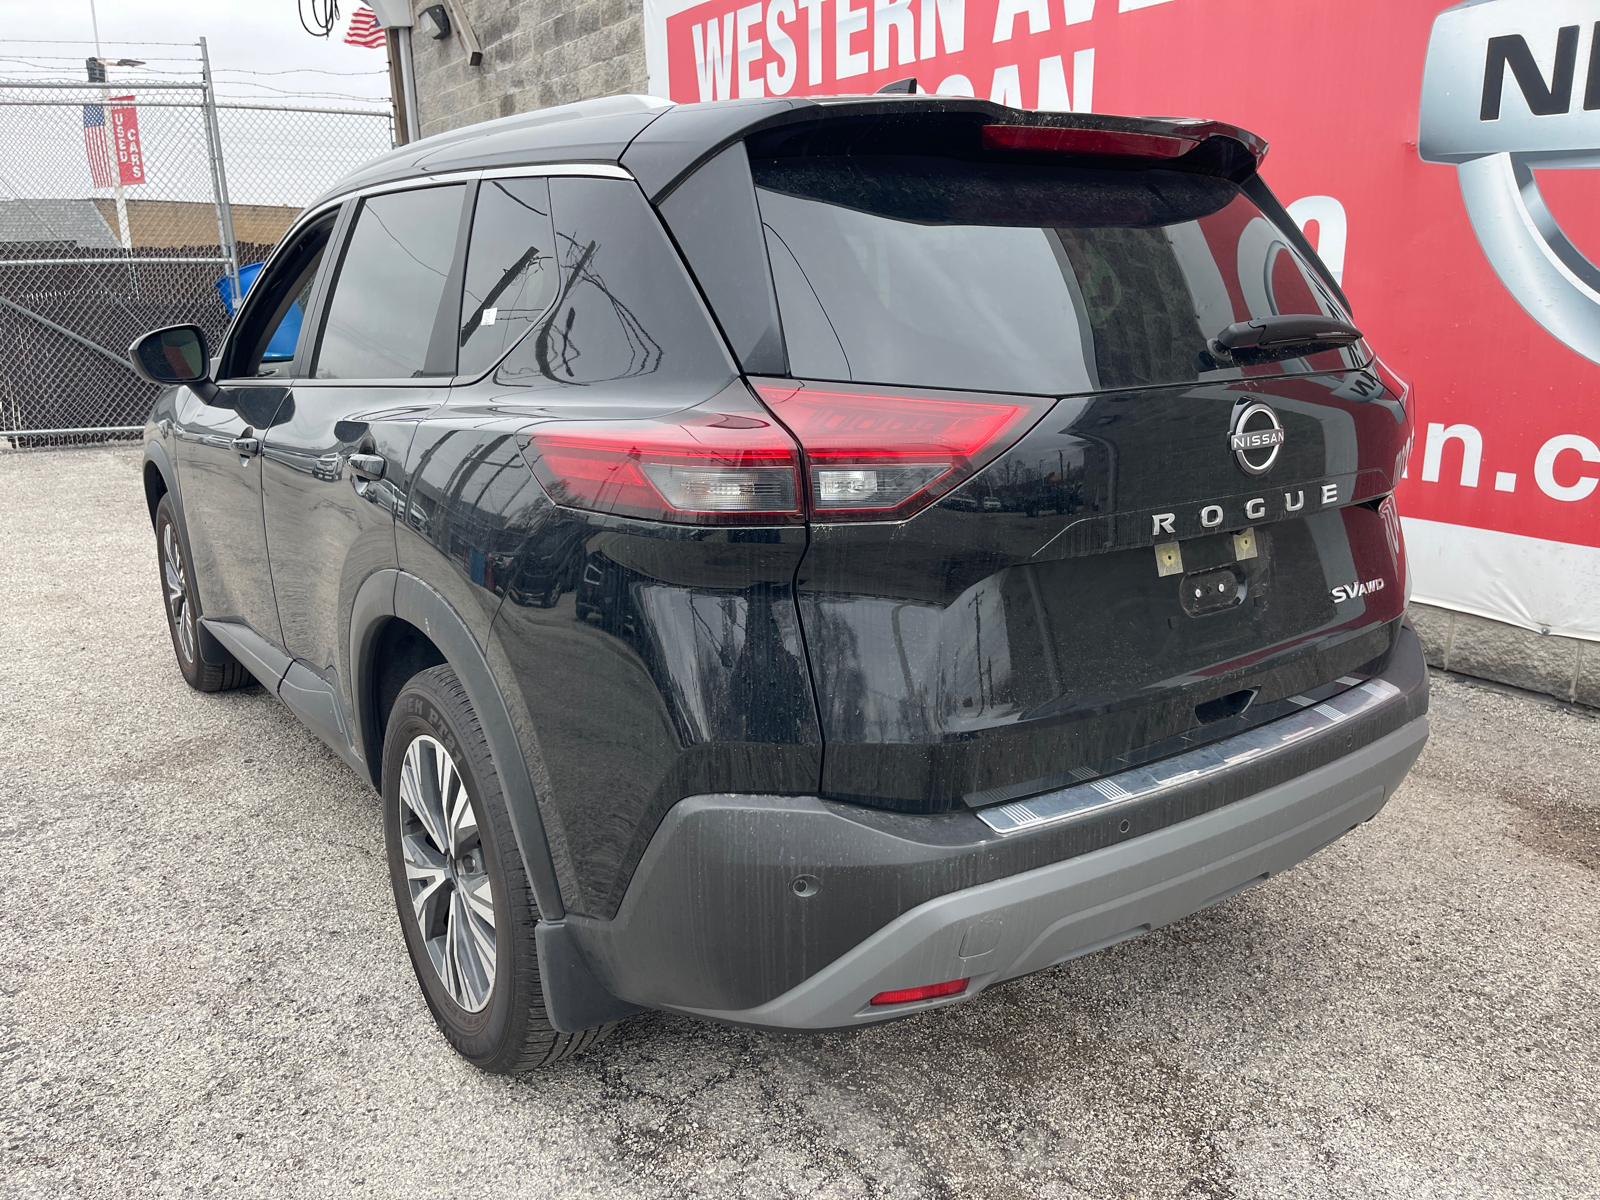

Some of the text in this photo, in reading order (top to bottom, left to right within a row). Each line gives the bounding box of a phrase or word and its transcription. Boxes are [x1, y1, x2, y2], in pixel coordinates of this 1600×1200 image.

[114, 113, 128, 163] USED
[127, 128, 141, 178] CARS
[1232, 431, 1284, 449] NISSAN
[1152, 484, 1338, 536] ROGUE
